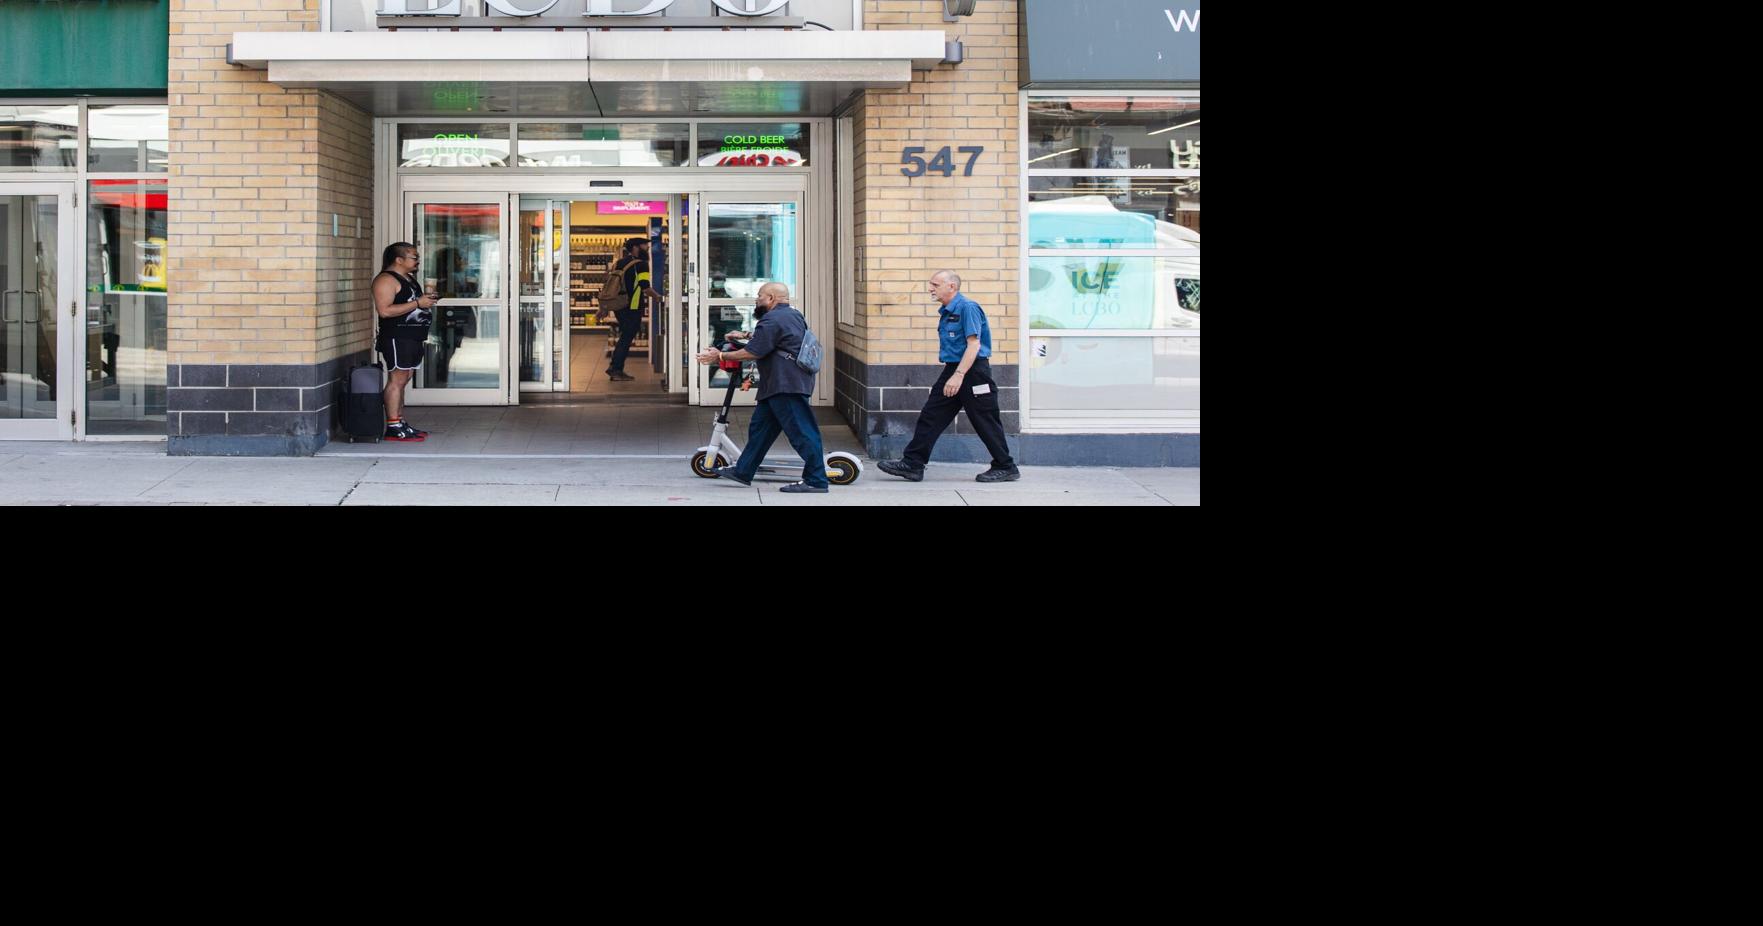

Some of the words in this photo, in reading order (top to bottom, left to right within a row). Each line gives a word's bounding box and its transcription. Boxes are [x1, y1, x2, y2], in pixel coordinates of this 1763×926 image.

[724, 135, 757, 144] COLD
[760, 135, 785, 144] BEER
[900, 146, 984, 177] 547
